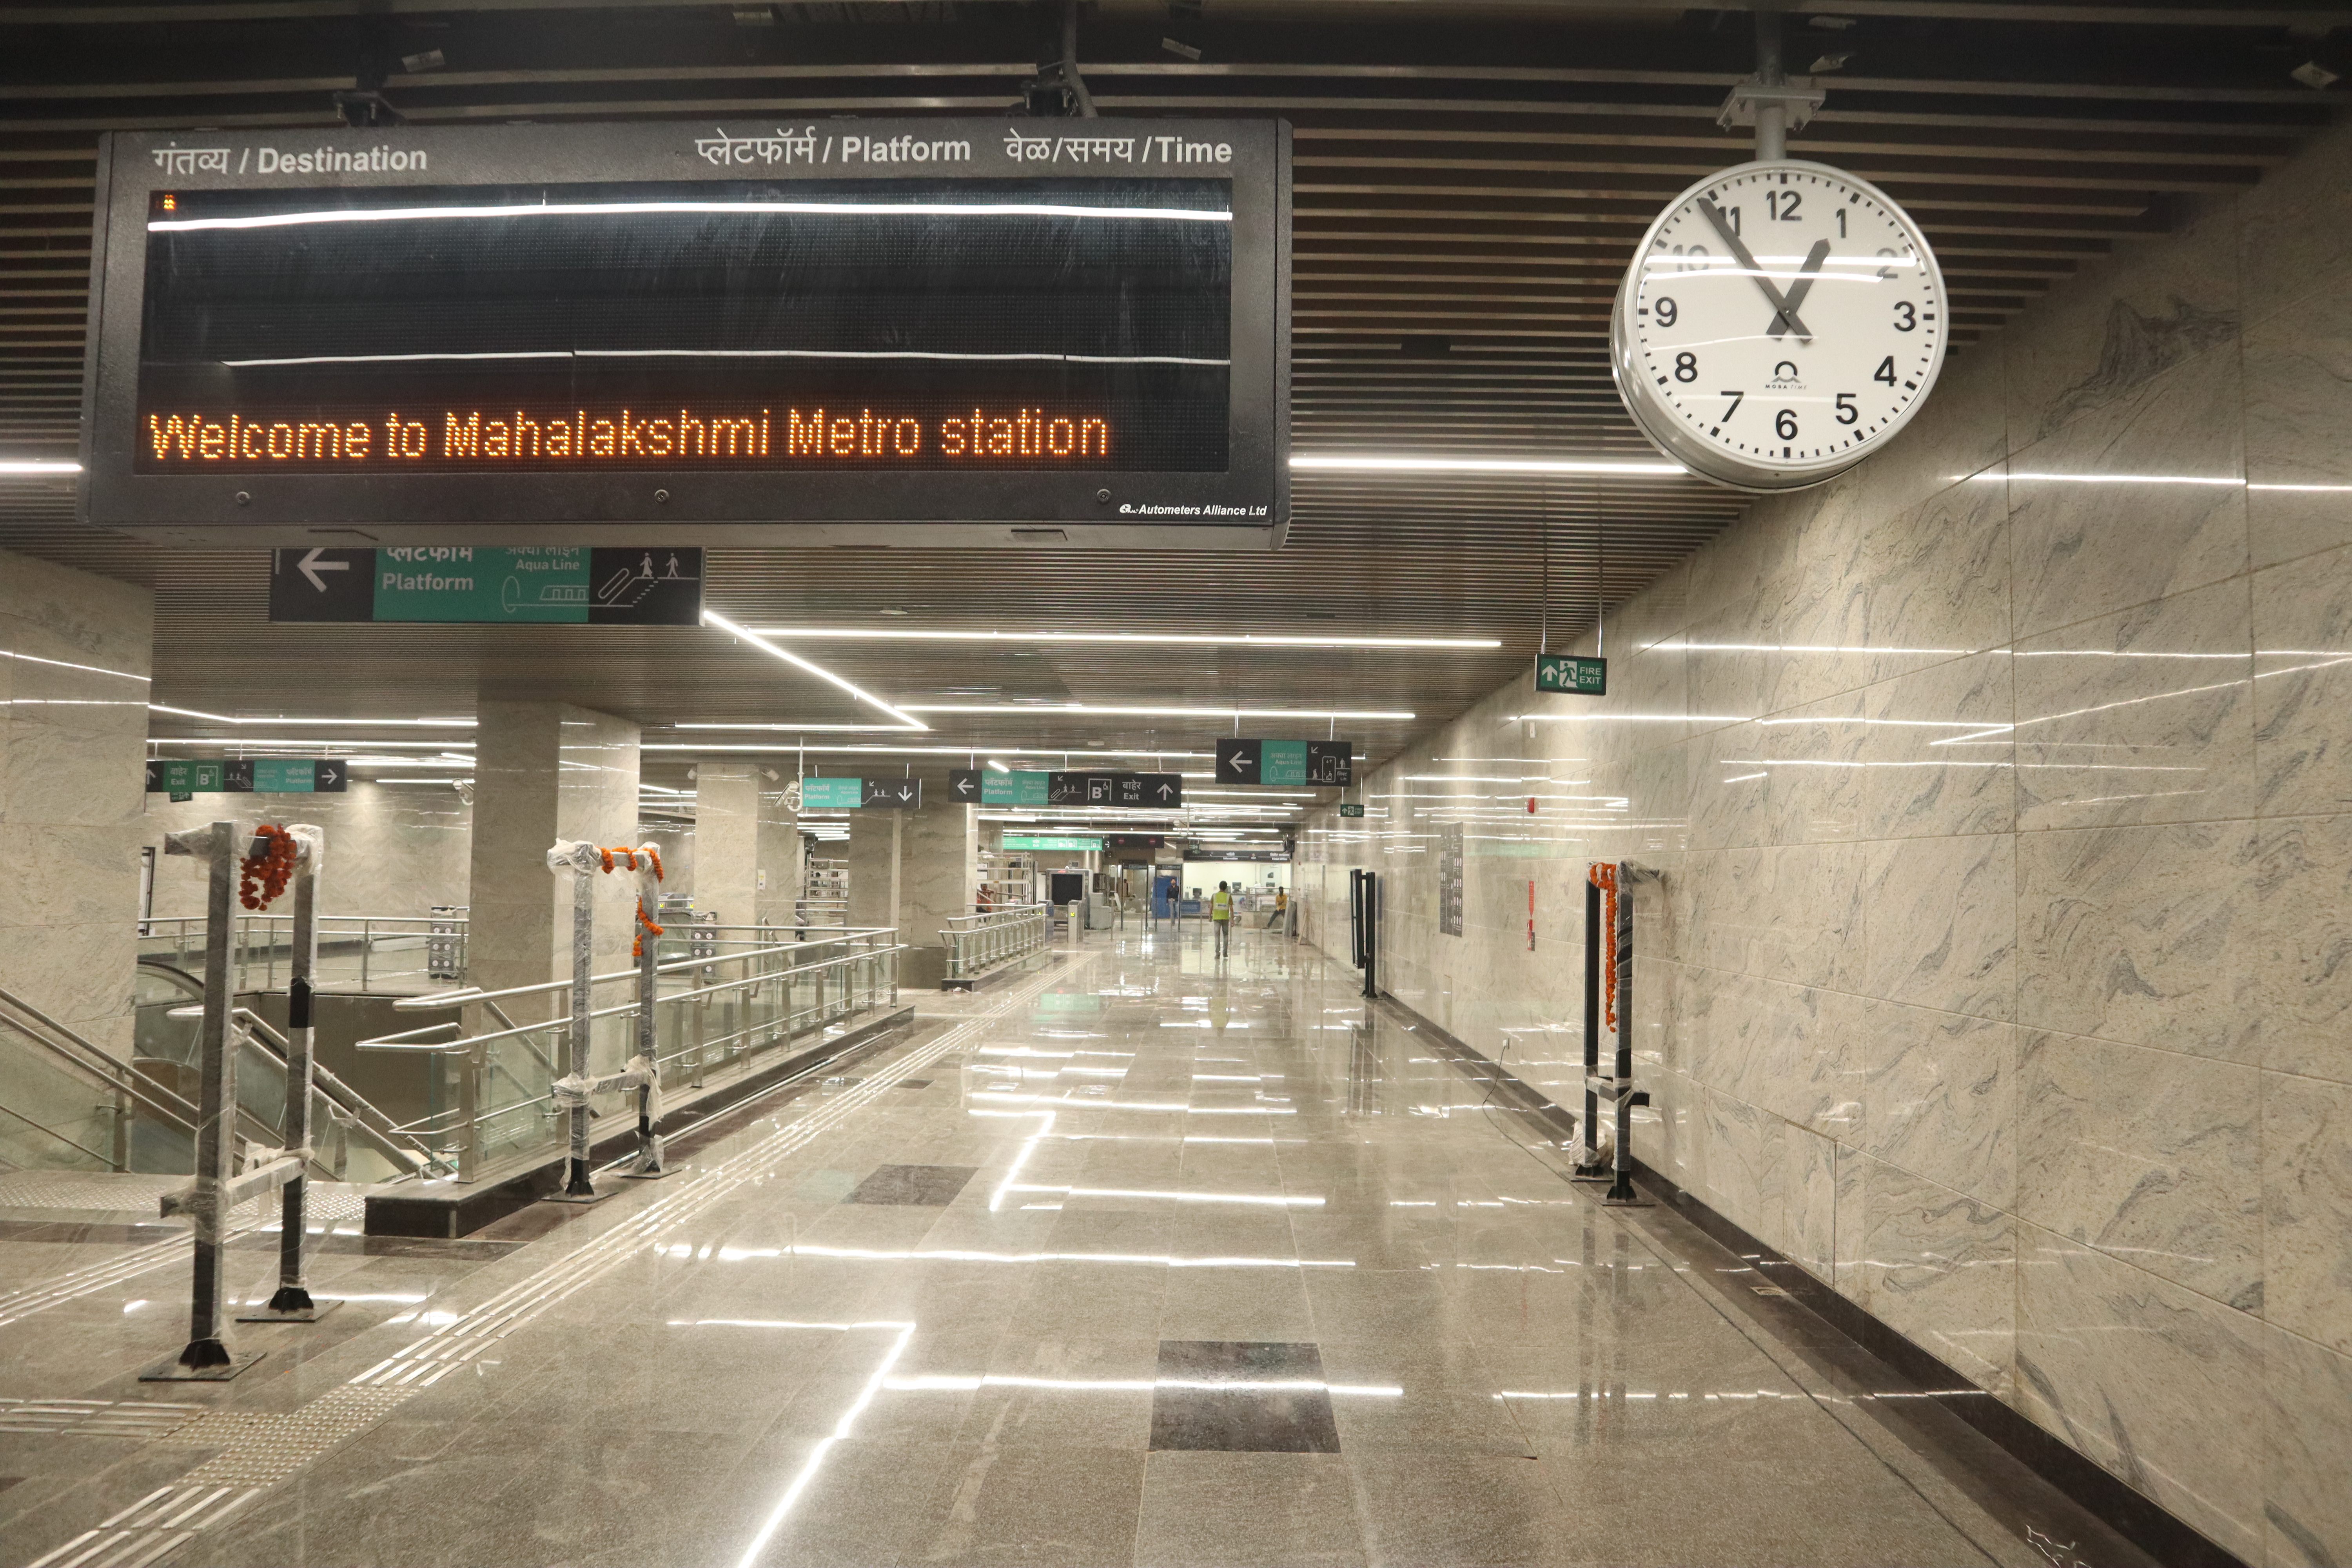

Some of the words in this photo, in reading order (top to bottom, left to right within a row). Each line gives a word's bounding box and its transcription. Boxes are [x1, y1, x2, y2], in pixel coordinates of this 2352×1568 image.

[152, 141, 230, 175] गंतव्य
[257, 145, 428, 174] Destination
[694, 125, 817, 165] प्लेटफॉर्म
[842, 135, 971, 162] Platform
[1766, 191, 1802, 221] 12
[1836, 208, 1846, 238] 1
[1876, 247, 1898, 278] 2
[1655, 297, 1677, 327] 9
[1894, 301, 1916, 332] 3
[1675, 352, 1698, 383] 8
[1874, 356, 1897, 387] 4
[1720, 391, 1744, 422] 7
[1836, 393, 1858, 425] 5
[150, 414, 371, 459] Welcome
[386, 412, 427, 457] to
[444, 409, 769, 457] Mahalakshmi
[789, 408, 920, 455] Metro
[941, 408, 1107, 455] station
[1776, 409, 1798, 440] 6
[1138, 504, 1200, 515] Autometers
[1203, 505, 1246, 515] Alliance
[1249, 505, 1267, 516] Ltd
[515, 559, 549, 572] Aqua
[552, 559, 580, 570] Line
[383, 573, 474, 590] Platform
[1580, 667, 1601, 675] FIRE
[1580, 676, 1601, 684] EXIT
[200, 774, 209, 785] B
[1092, 787, 1102, 799] B
[1122, 779, 1142, 790] बाहेर
